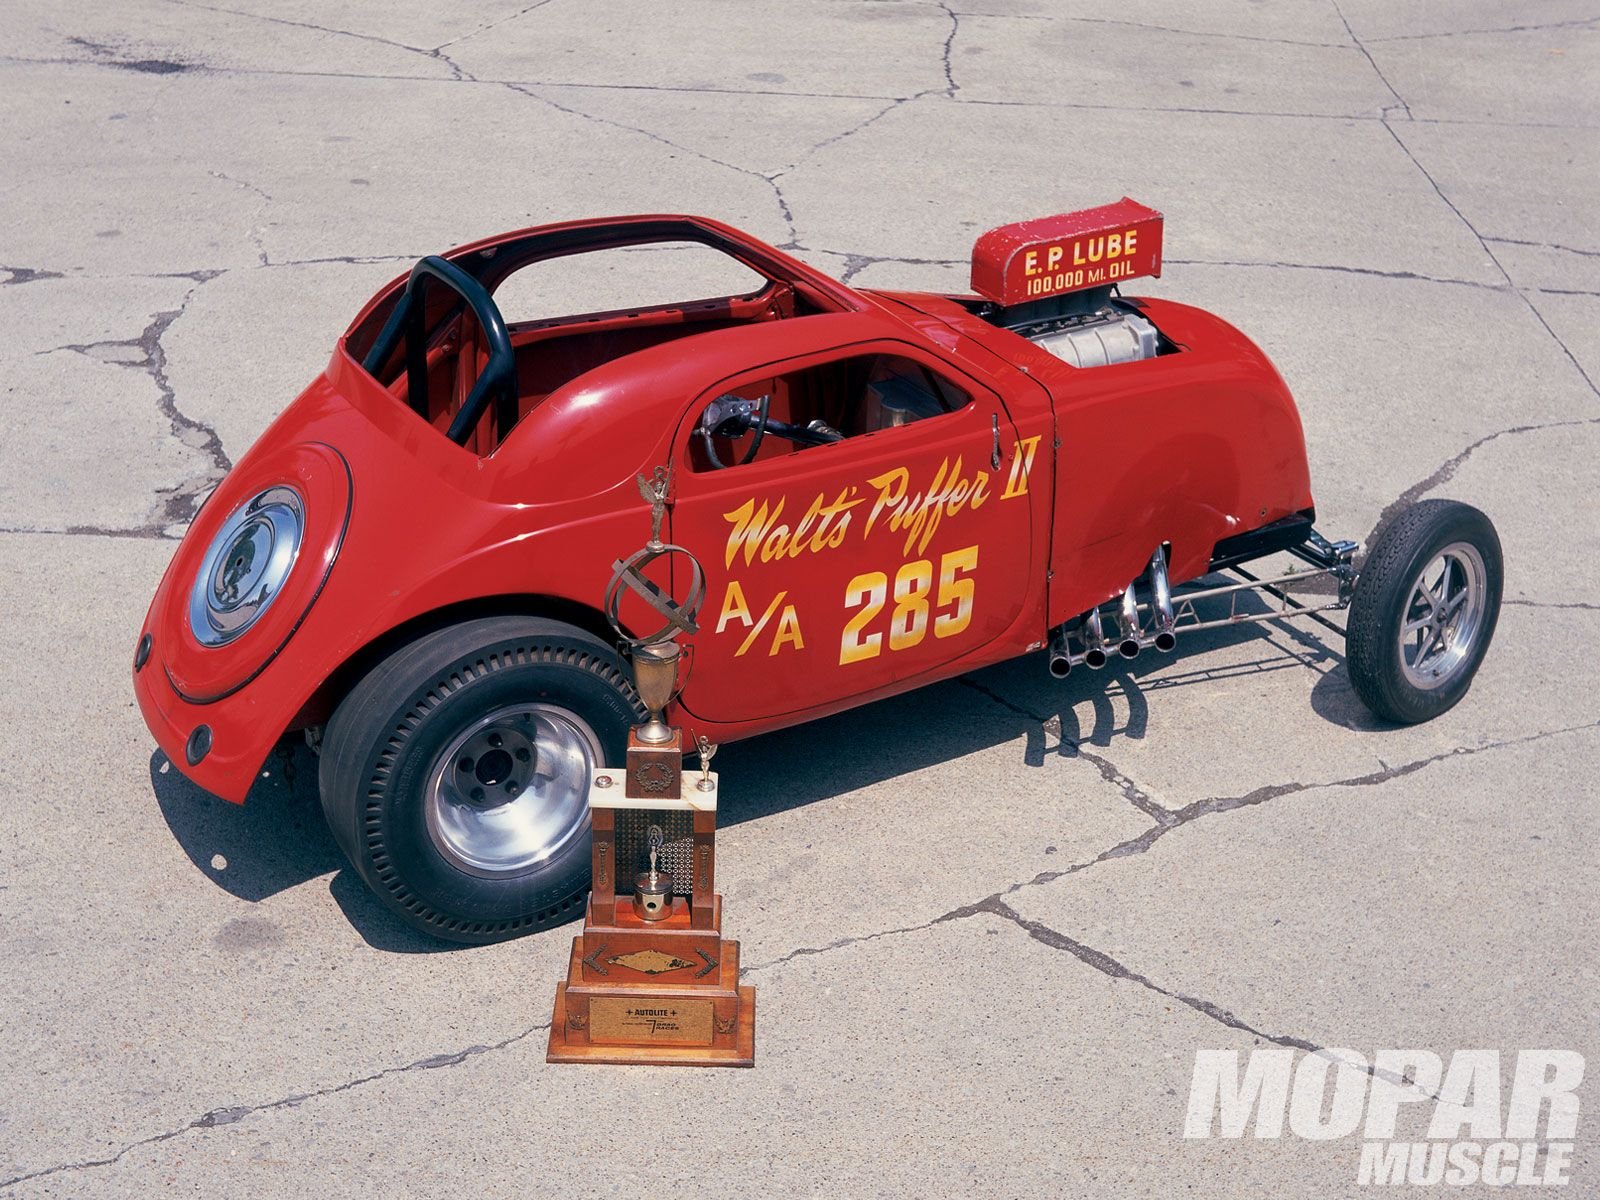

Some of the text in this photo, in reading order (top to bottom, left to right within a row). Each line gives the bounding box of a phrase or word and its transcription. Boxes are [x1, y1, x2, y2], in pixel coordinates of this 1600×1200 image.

[1027, 260, 1135, 296] 100,000 MI. OIL
[1073, 230, 1137, 265] LUBE
[863, 453, 991, 558] Puffer
[715, 580, 805, 657] A/A
[839, 544, 979, 666] 285
